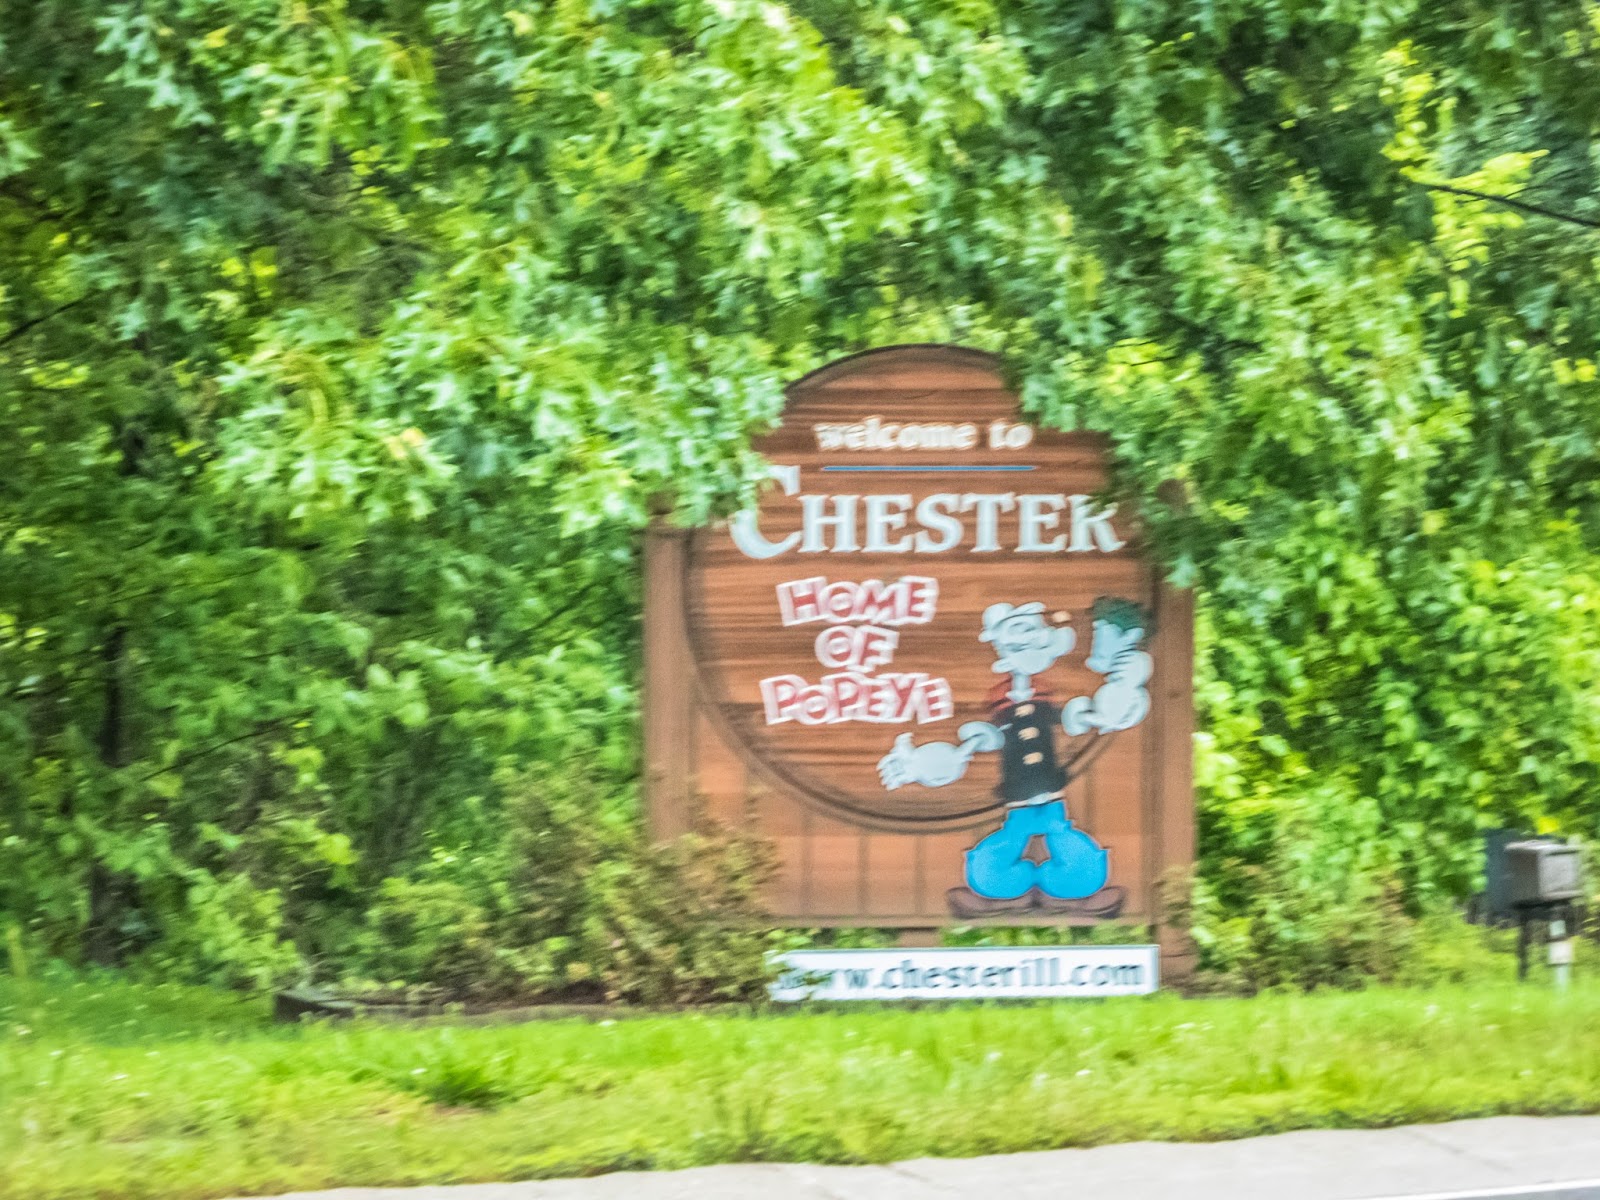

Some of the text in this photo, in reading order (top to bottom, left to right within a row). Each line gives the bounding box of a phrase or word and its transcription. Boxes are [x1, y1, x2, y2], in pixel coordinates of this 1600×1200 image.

[813, 415, 1033, 451] welcome to
[728, 465, 1126, 559] CHESTER
[775, 575, 939, 627] HOME
[814, 625, 900, 672] OF
[759, 672, 954, 726] POPEYE
